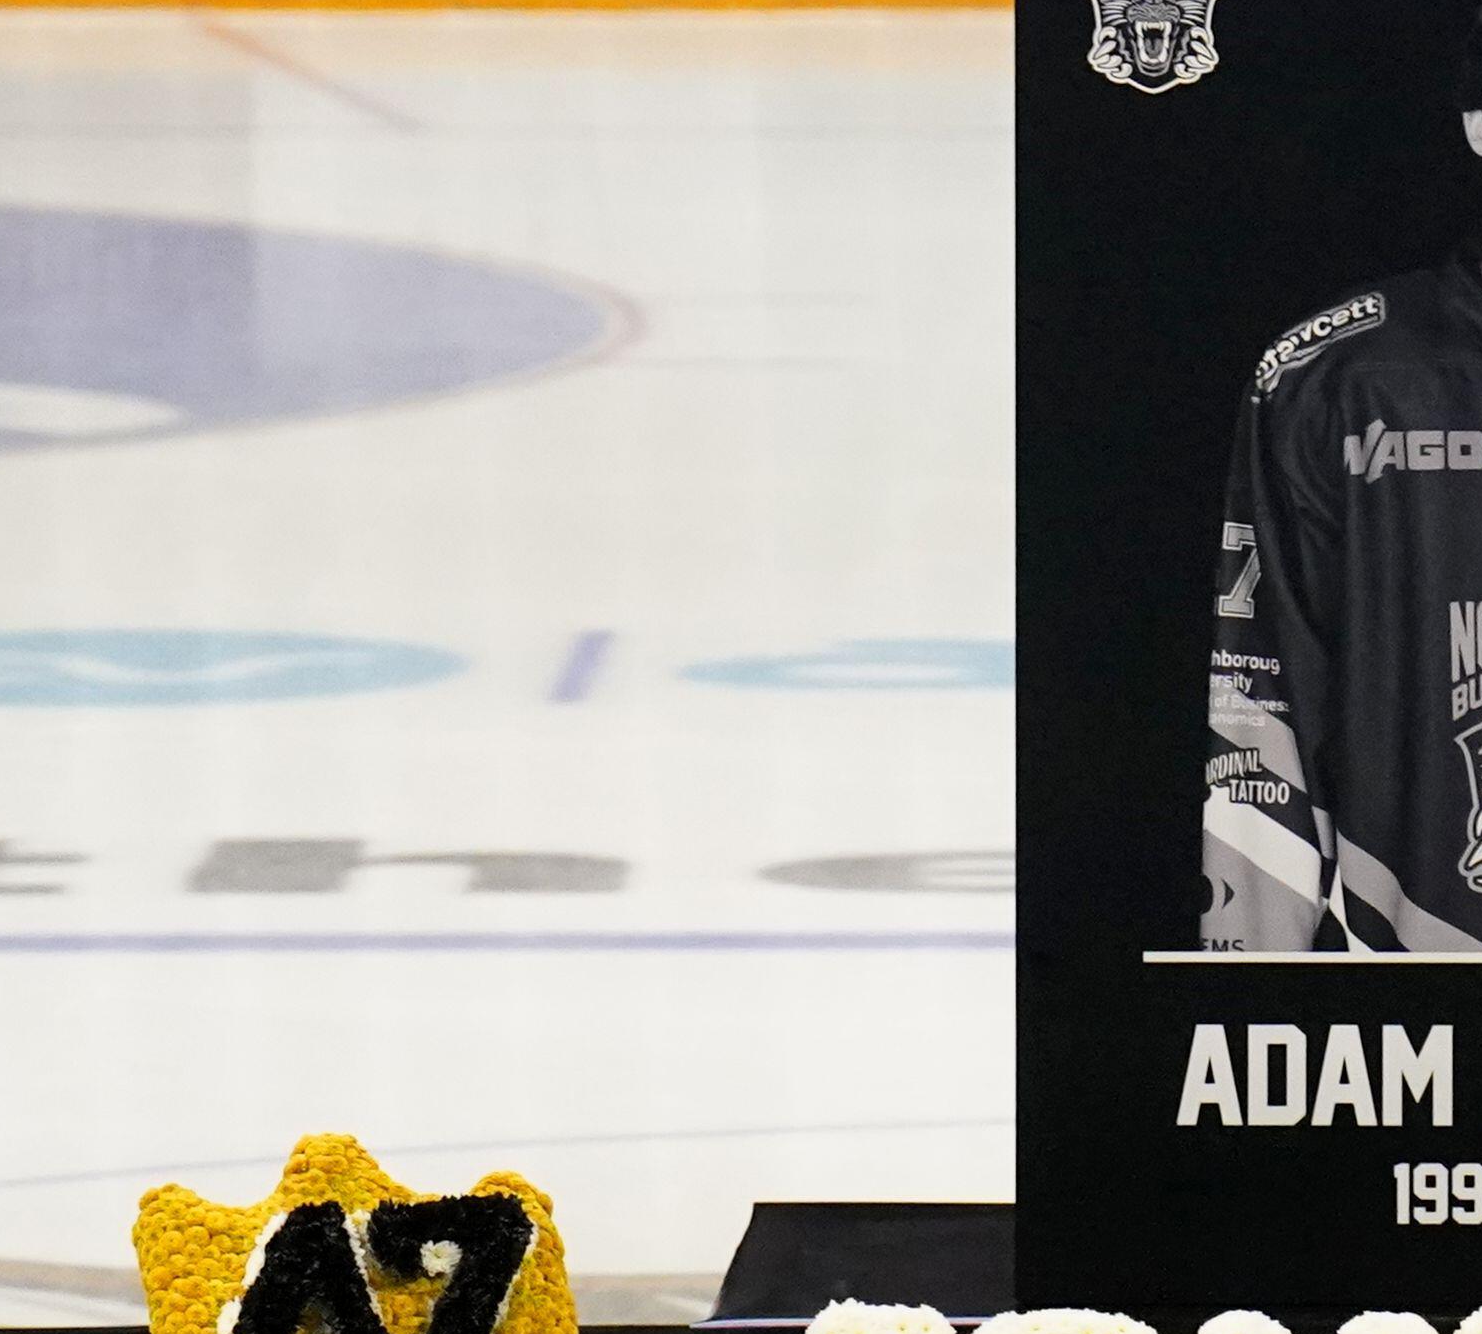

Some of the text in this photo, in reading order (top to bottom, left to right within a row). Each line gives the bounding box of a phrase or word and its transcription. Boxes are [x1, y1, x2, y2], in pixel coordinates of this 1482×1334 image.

[1221, 521, 1262, 619] 7
[1228, 778, 1290, 805] TATTOO
[1176, 1022, 1454, 1128] ADAM
